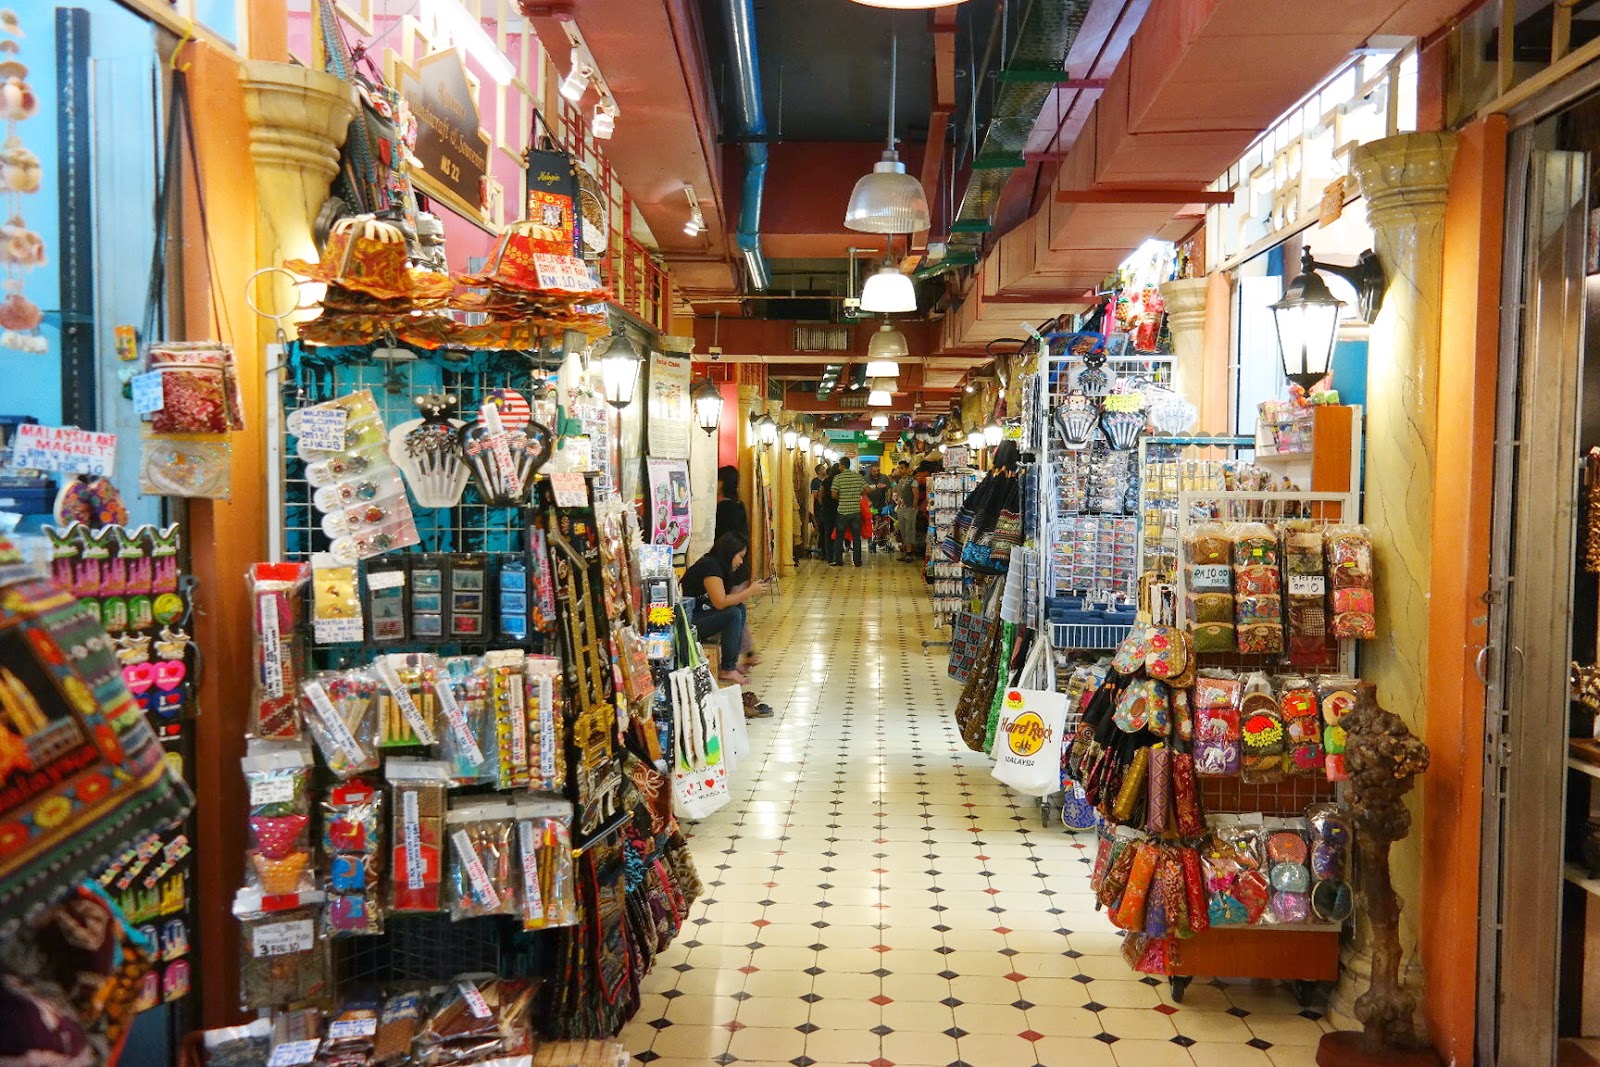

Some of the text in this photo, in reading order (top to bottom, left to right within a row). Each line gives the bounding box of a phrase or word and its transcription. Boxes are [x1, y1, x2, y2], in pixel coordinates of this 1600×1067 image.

[21, 425, 92, 444] MALAYSIA
[35, 439, 106, 456] MAGNET
[1001, 717, 1053, 743] Hard Rock
[1005, 755, 1035, 767] MALAYSIA
[260, 945, 268, 954] 3
